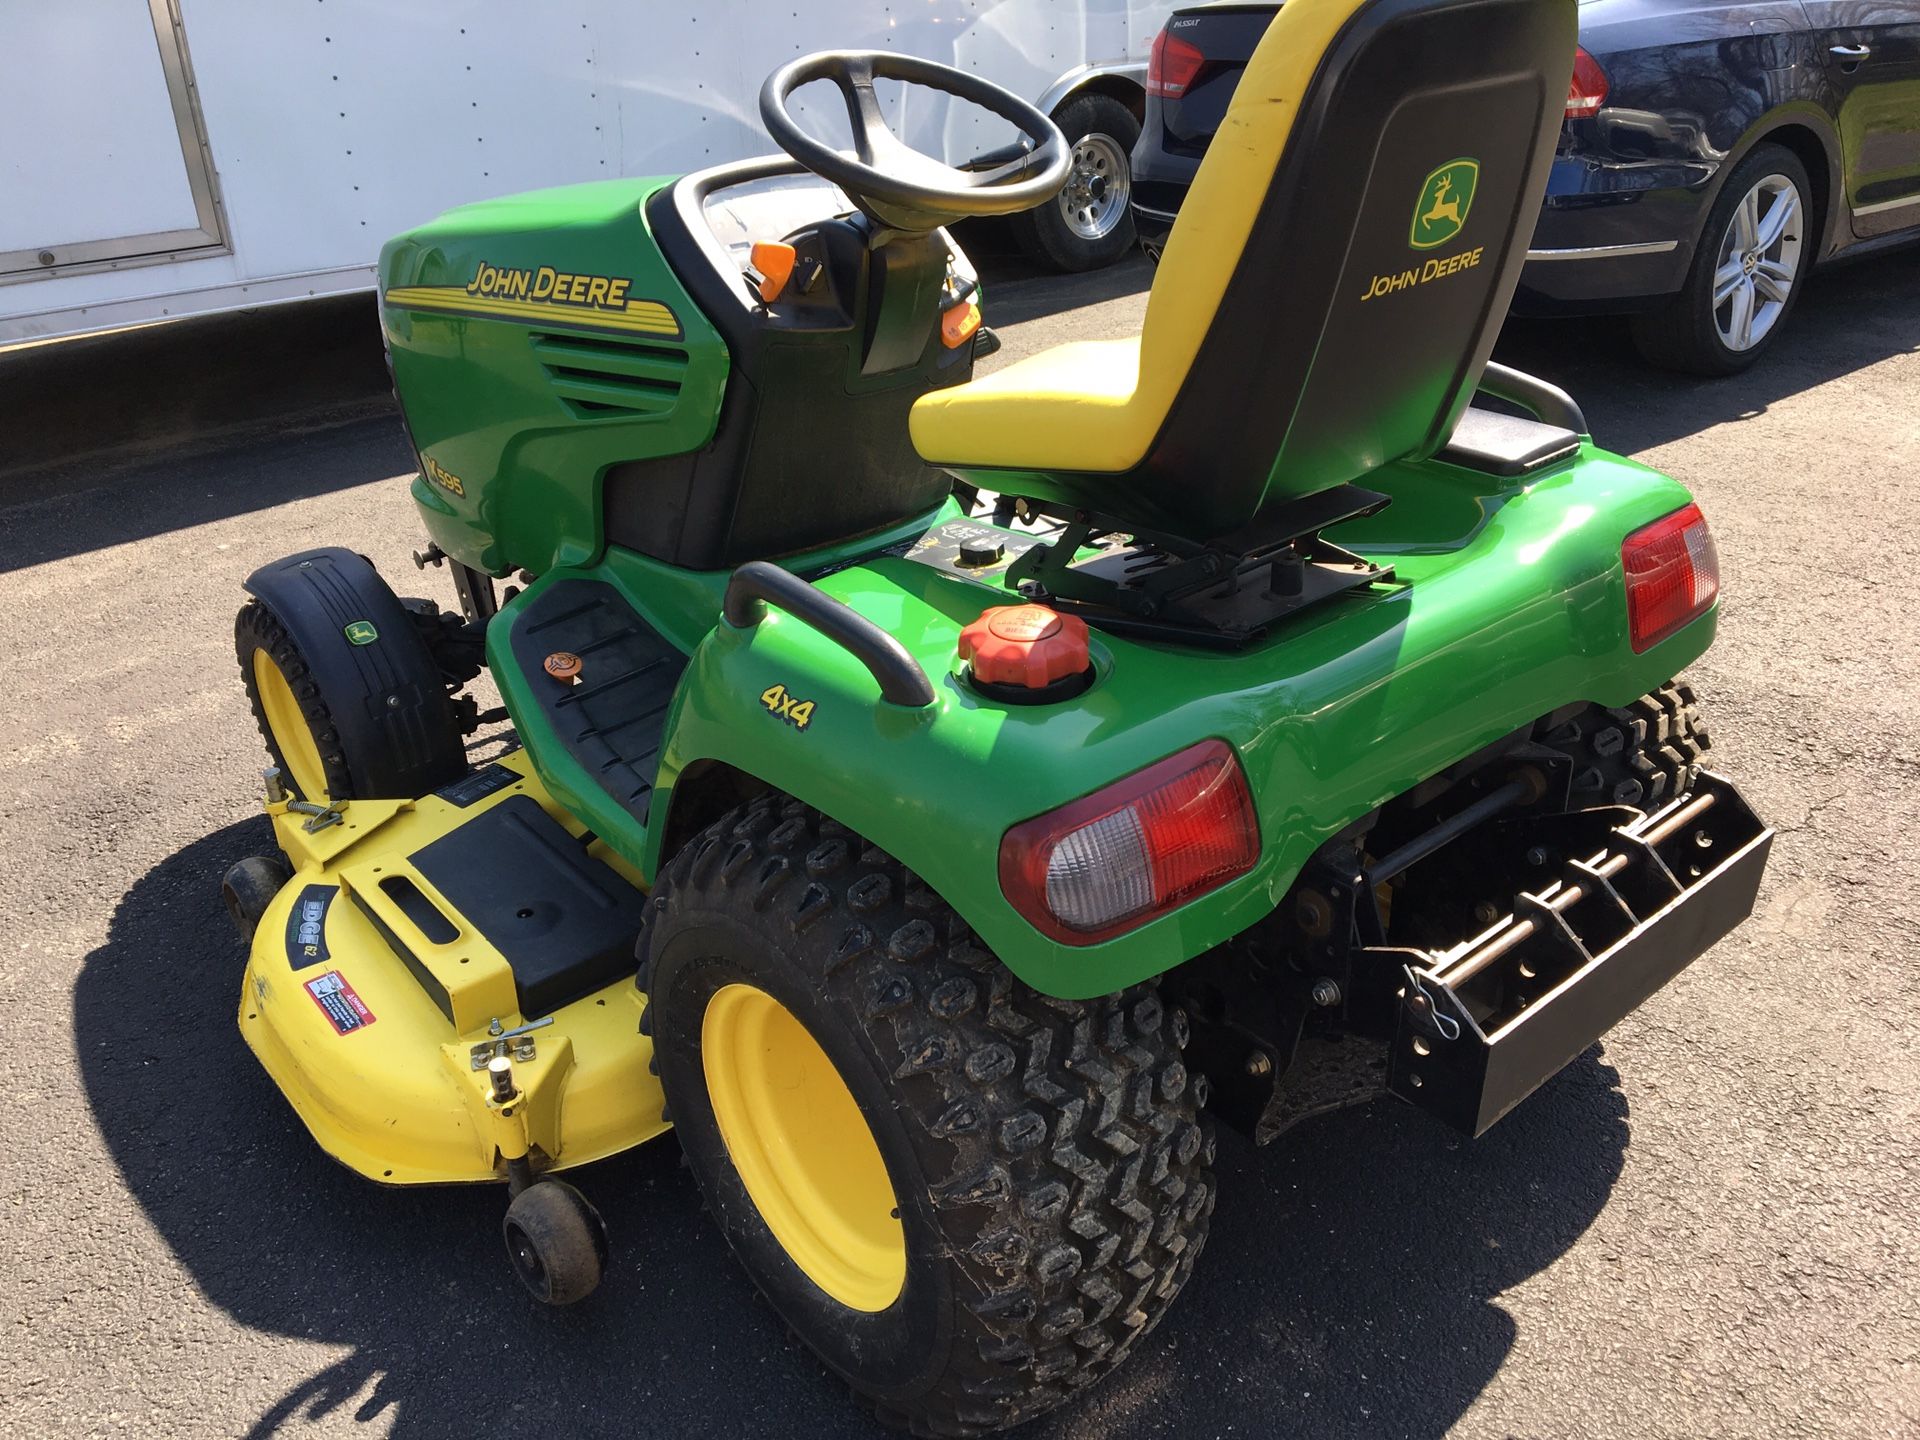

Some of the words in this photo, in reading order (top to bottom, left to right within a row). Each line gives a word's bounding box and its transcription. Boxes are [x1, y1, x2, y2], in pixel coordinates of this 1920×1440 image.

[1174, 19, 1200, 28] PASSAT
[467, 262, 531, 296] JOHN
[532, 266, 630, 306] DEERE
[1361, 268, 1420, 301] JOHN
[1421, 246, 1484, 283] DEERE
[298, 900, 324, 945] EDGE
[304, 945, 317, 957] 62
